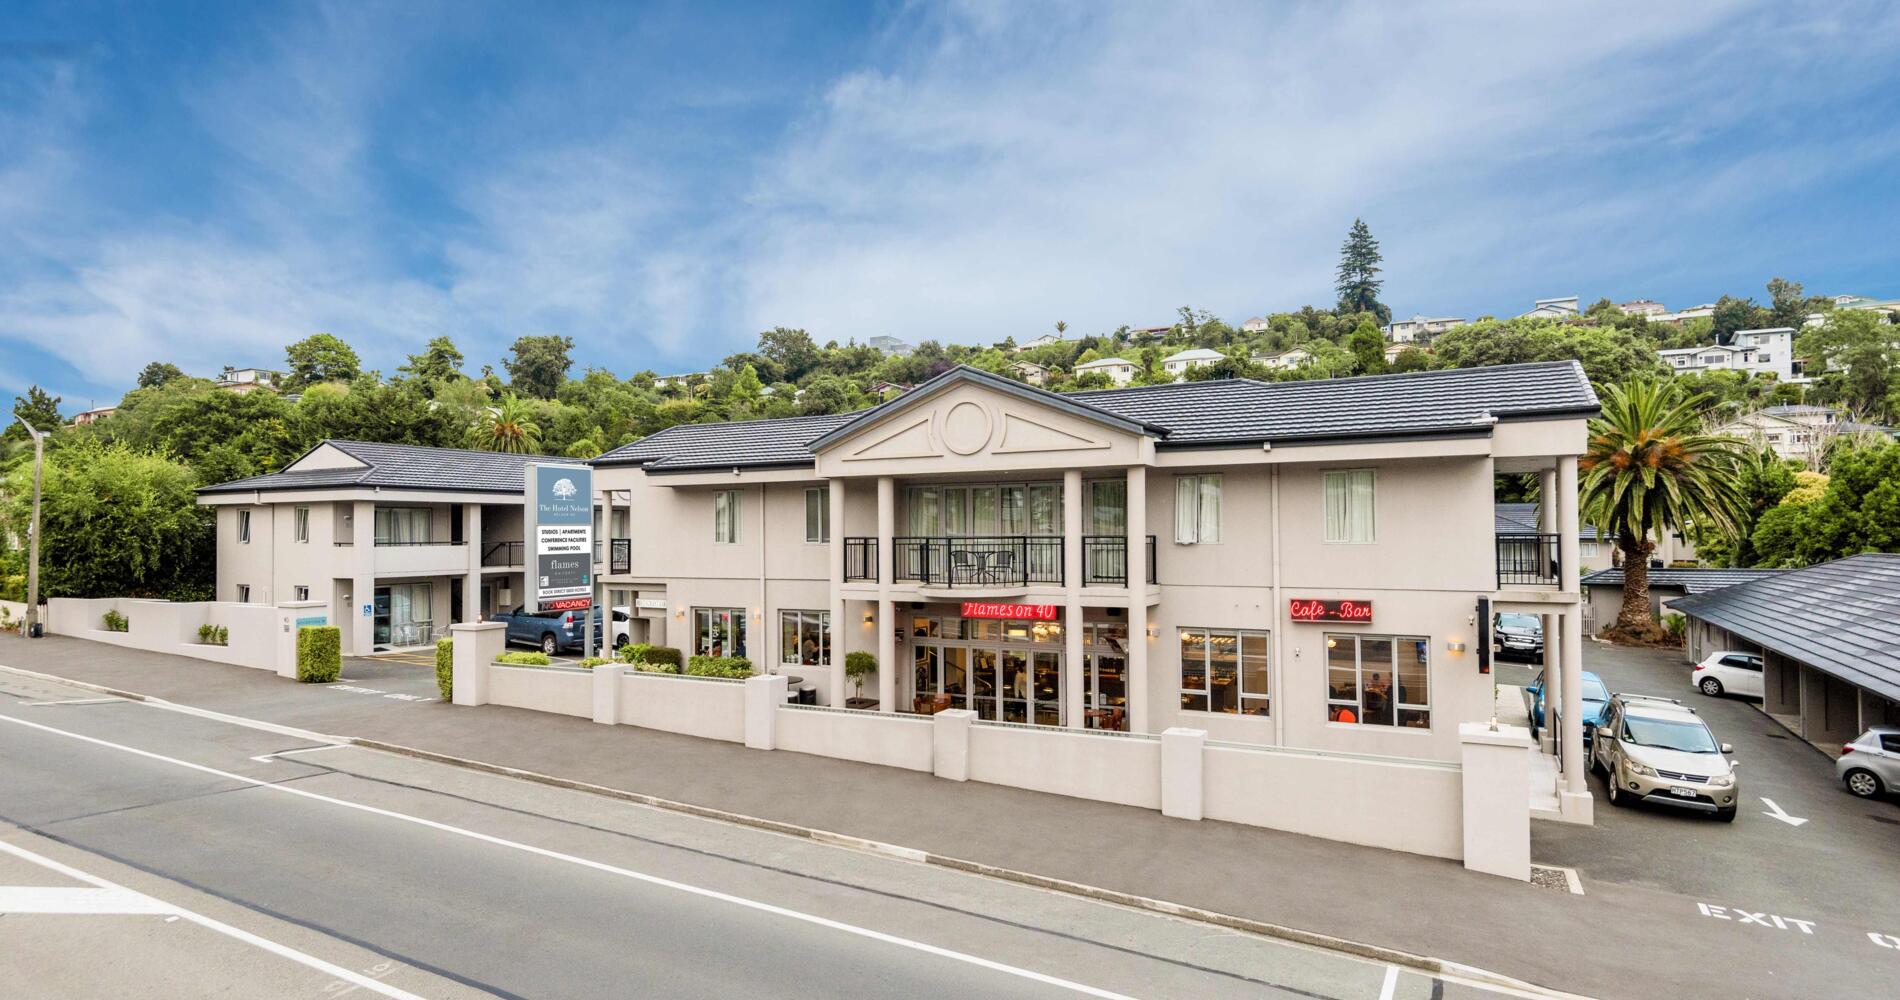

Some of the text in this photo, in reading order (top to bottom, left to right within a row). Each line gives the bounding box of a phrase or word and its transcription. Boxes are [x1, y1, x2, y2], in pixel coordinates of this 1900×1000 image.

[552, 504, 569, 512] Hotel
[551, 560, 580, 569] flames
[556, 599, 591, 608] VACANCY
[963, 602, 1054, 618] Flames on 40
[1291, 600, 1325, 621] Cafe
[1340, 602, 1372, 618] Bar
[1697, 902, 1816, 935] EXIT
